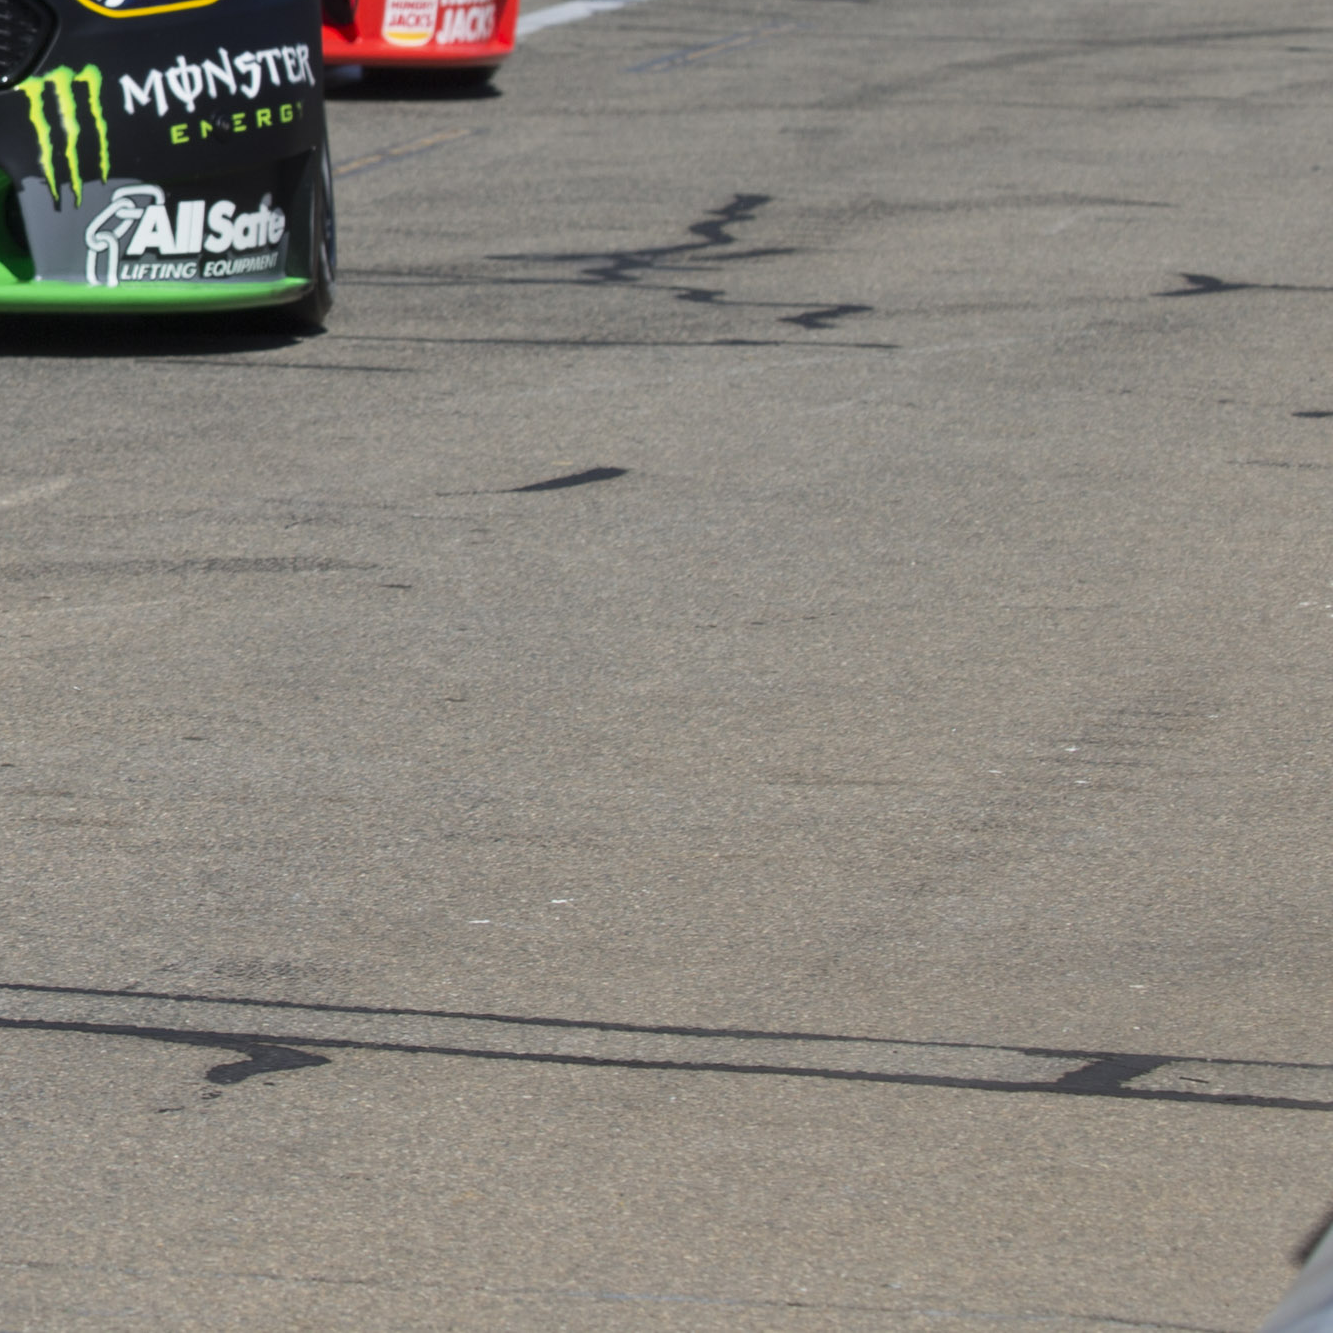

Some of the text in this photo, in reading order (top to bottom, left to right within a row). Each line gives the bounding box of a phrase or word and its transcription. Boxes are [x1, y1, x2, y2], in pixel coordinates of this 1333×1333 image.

[119, 42, 316, 118] MONSTER
[121, 252, 280, 282] LIFTING EQUIPMENT
